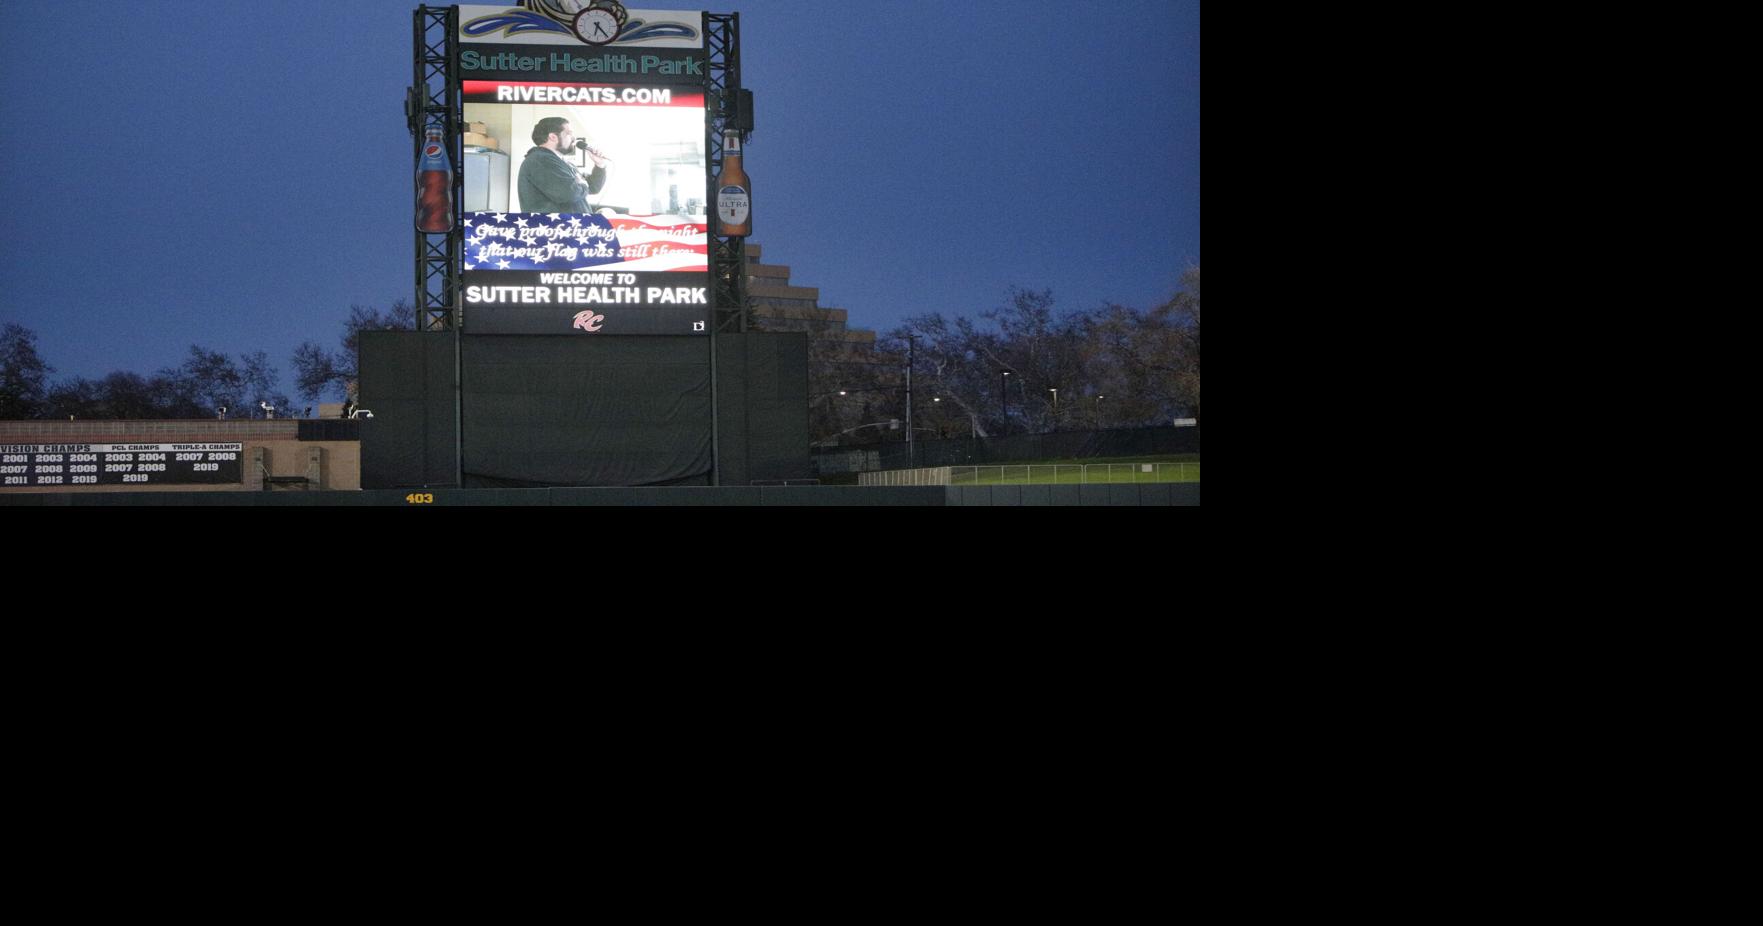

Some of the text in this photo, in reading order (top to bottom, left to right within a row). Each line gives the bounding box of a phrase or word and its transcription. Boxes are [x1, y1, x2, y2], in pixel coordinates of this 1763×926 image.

[460, 50, 703, 75] Sutter Health Park
[498, 85, 671, 104] RIVERCATS.COM
[719, 197, 747, 207] ULTRA
[475, 224, 516, 240] Gave
[518, 223, 564, 241] proof
[480, 243, 512, 256] that
[543, 243, 578, 261] flag
[582, 247, 614, 257] was
[617, 244, 651, 257] still
[540, 273, 636, 285] WELCOME TO
[466, 286, 707, 305] SUTTER HEALTH PARK
[573, 310, 605, 332] RC
[3, 454, 97, 463] 2001 2003 2004
[105, 453, 166, 462] 2003 2004
[176, 453, 236, 461] 2007 2008
[0, 465, 97, 474] 2007 2008 2009
[105, 463, 166, 472] 2007 2008
[193, 463, 219, 471] 2019
[4, 475, 97, 484] 2011 2012 2019
[122, 474, 149, 482] 2019
[406, 493, 433, 503] 403
